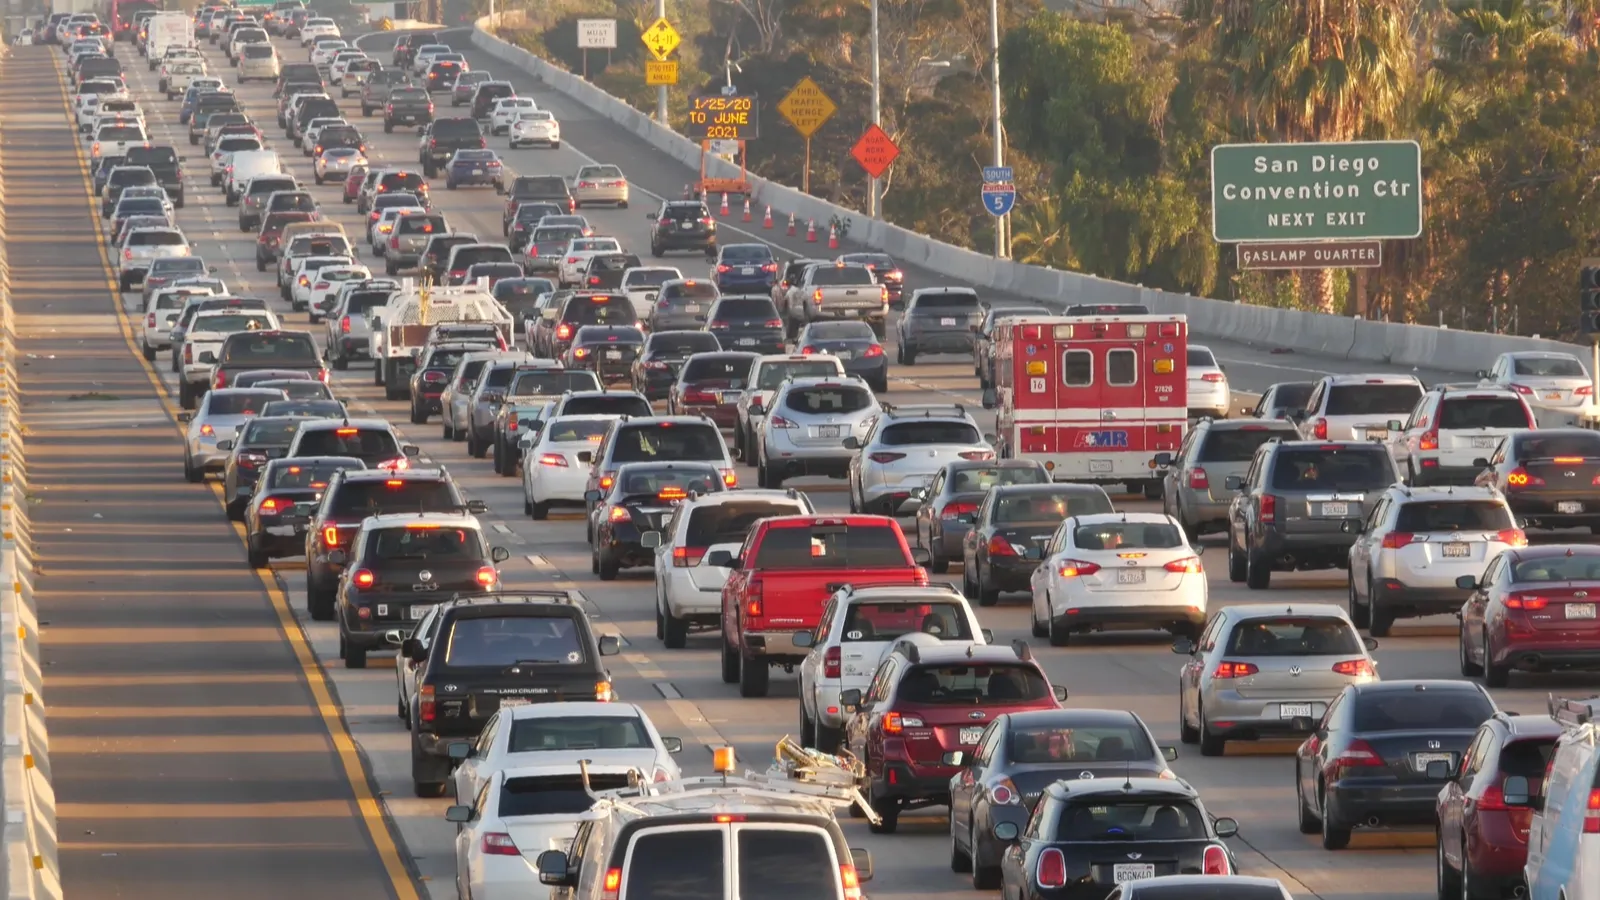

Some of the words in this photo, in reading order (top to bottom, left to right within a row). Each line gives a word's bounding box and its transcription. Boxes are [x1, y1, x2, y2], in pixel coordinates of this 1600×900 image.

[797, 88, 818, 96] THRU
[694, 97, 751, 110] 1/25/20
[689, 111, 706, 124] TO
[714, 111, 748, 124] JUNE
[791, 108, 824, 116] MERGE
[796, 118, 818, 126] LEFT
[707, 126, 738, 138] 2021
[1254, 155, 1298, 173] San
[1312, 154, 1380, 177] Diego
[985, 169, 1011, 180] SOUTH
[1223, 181, 1360, 200] Convention
[1373, 179, 1411, 197] Ctr
[994, 197, 1003, 210] 5
[1267, 213, 1315, 227] NEXT
[1326, 212, 1367, 226] EXIT
[1243, 250, 1307, 262] GASLAMP
[1314, 248, 1376, 261] QUARTER
[1032, 380, 1043, 389] 16
[1073, 430, 1128, 448] AMR
